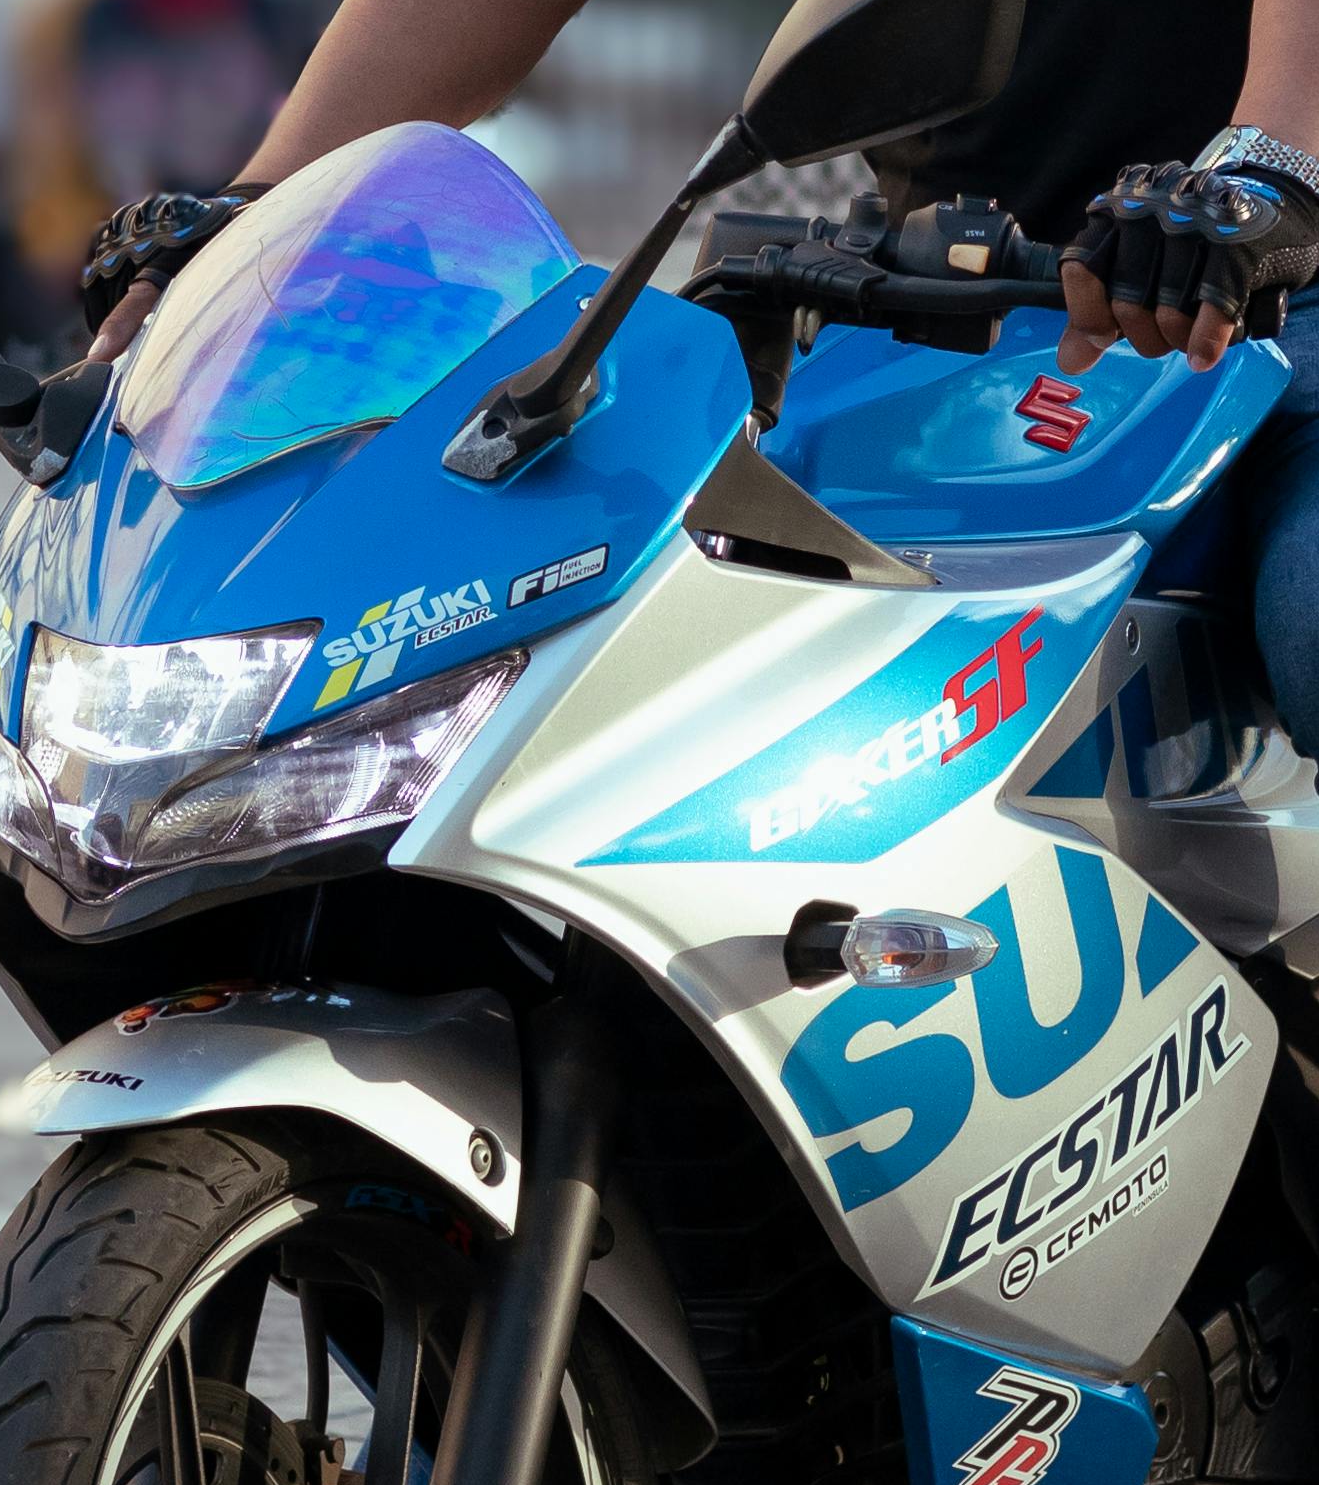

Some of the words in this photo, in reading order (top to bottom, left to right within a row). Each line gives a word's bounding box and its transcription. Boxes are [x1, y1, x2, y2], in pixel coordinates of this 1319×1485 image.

[562, 562, 601, 582] INJECTION
[563, 559, 582, 571] FUEL
[322, 579, 492, 667] SUZUKI
[415, 605, 498, 649] ECSTAR
[940, 603, 1044, 766] SF
[929, 983, 1244, 1289] ECSTAR
[1046, 1153, 1168, 1264] CFMOTO
[1133, 1180, 1169, 1213] PENINSULA
